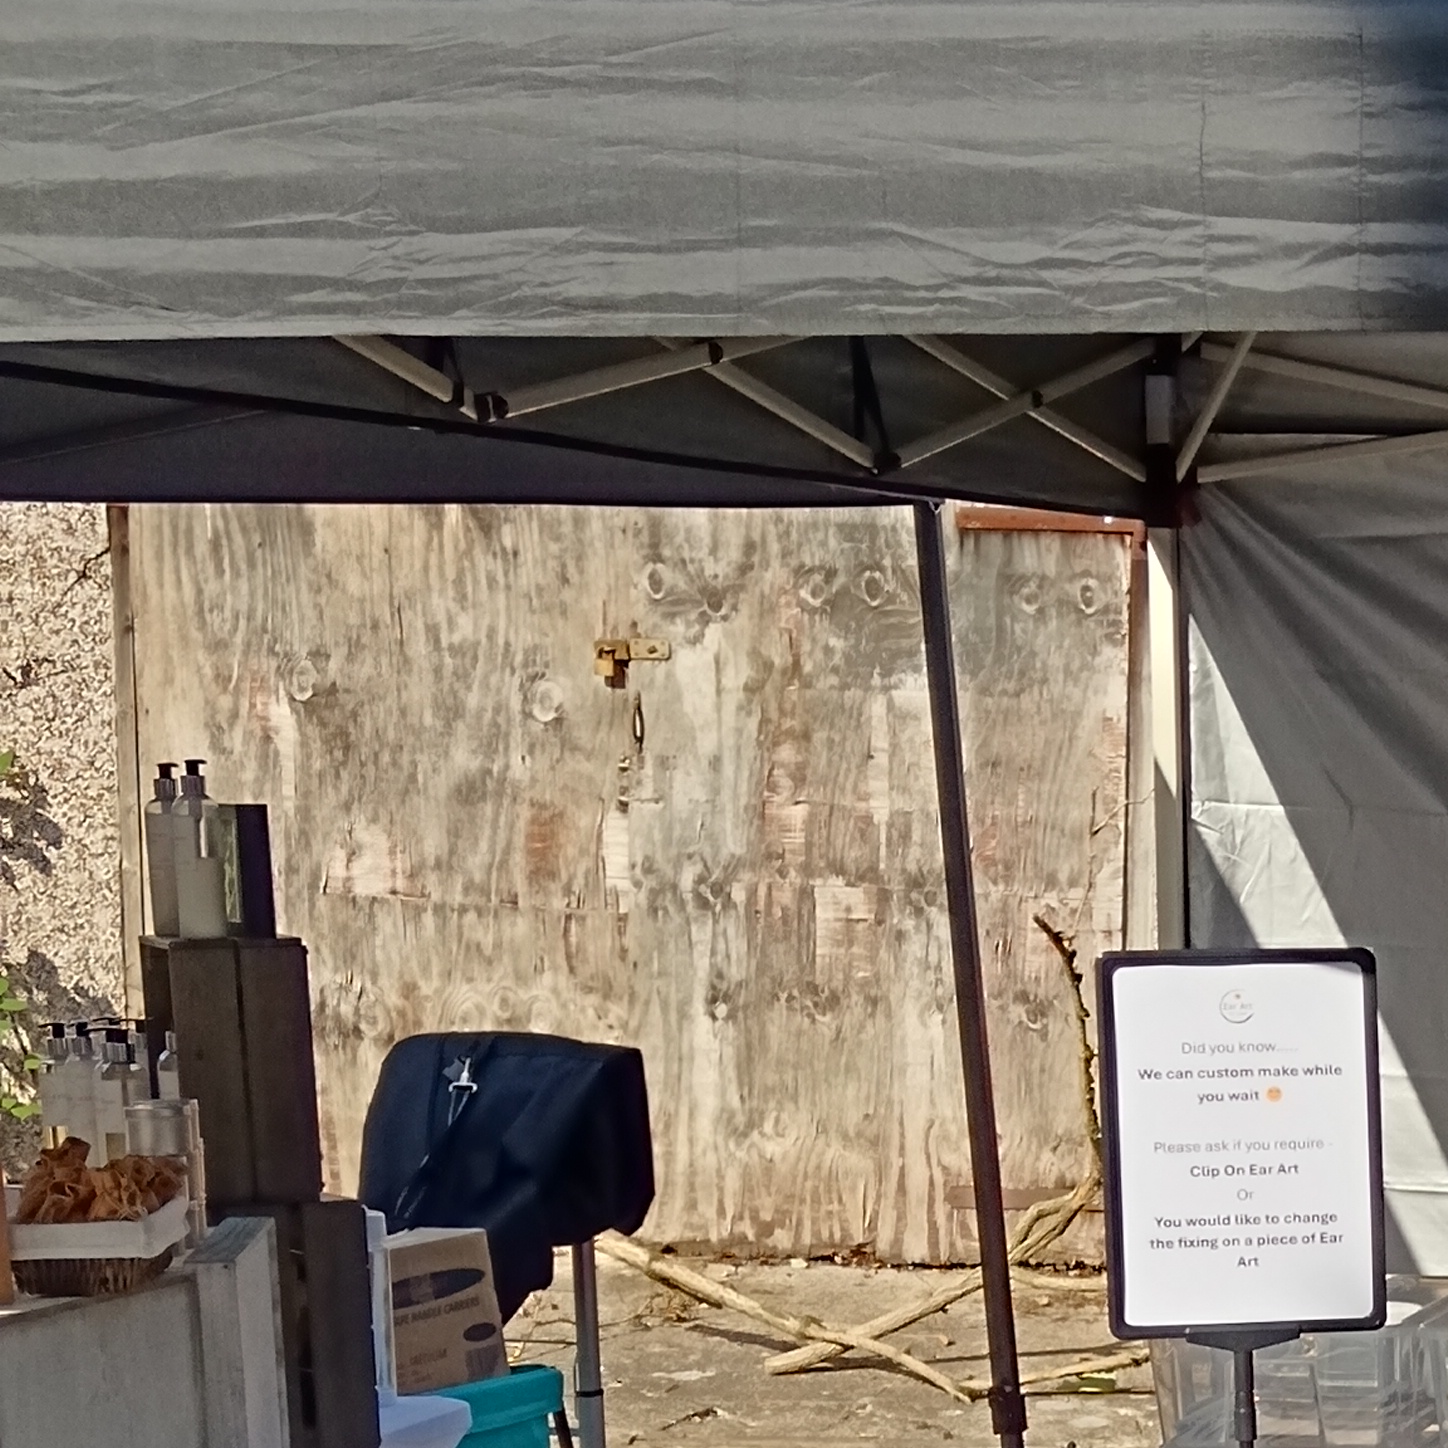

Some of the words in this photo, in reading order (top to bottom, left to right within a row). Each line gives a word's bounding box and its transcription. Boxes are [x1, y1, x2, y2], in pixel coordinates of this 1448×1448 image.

[1182, 1042, 1205, 1054] Did
[1209, 1044, 1234, 1056] you
[1138, 1069, 1162, 1080] We
[1166, 1069, 1193, 1079] can
[1198, 1068, 1253, 1079] custom
[1259, 1066, 1298, 1077] make
[1302, 1065, 1342, 1076] while
[1198, 1091, 1224, 1104] you
[1228, 1090, 1259, 1101] wait
[1154, 1142, 1201, 1153] Please
[1205, 1141, 1229, 1151] ask
[1233, 1141, 1241, 1150] if
[1245, 1142, 1270, 1153] you
[1275, 1139, 1324, 1150] require
[1190, 1165, 1220, 1178] Clip
[1224, 1164, 1245, 1176] On
[1250, 1164, 1273, 1175] Ear
[1277, 1163, 1299, 1174] Art
[1236, 1189, 1254, 1200] Or
[1155, 1217, 1181, 1227] You
[1186, 1215, 1231, 1226] would
[1235, 1214, 1261, 1225] like
[1266, 1214, 1279, 1224] to
[1284, 1212, 1337, 1225] change
[1150, 1239, 1173, 1249] the
[1178, 1237, 1218, 1249] fixing
[1223, 1237, 1240, 1246] on
[1245, 1237, 1252, 1246] a
[1258, 1235, 1298, 1247] piece
[1302, 1233, 1315, 1243] of
[1320, 1232, 1343, 1243] Ear
[1237, 1257, 1258, 1267] Art
